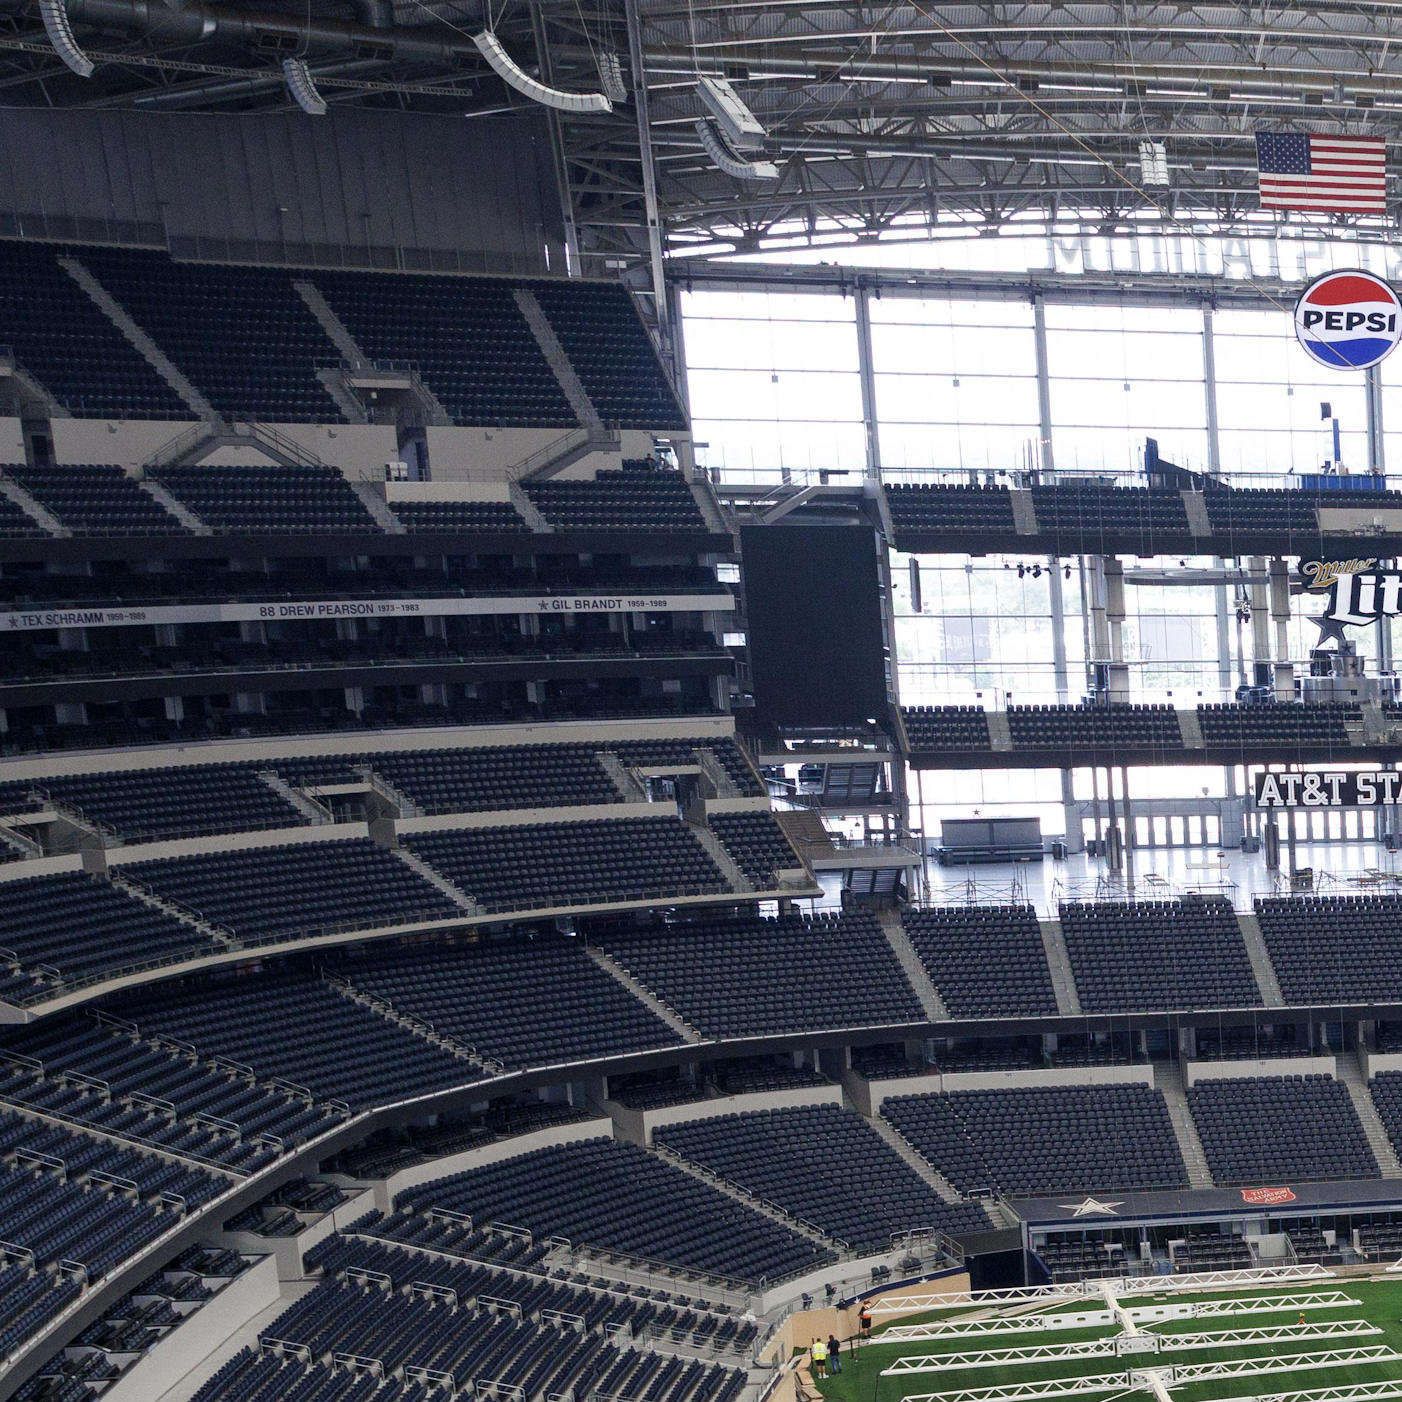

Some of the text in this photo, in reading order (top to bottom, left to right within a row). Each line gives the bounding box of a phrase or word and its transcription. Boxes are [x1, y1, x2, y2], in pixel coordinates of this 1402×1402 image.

[1303, 310, 1396, 333] PEPSI
[1303, 557, 1378, 589] Miller
[259, 606, 275, 617] 88
[280, 605, 315, 616] DREW
[318, 603, 374, 615] PEARSON
[552, 599, 572, 610] GIL
[574, 599, 623, 609] BRANDT
[21, 614, 42, 627] TEX
[46, 611, 104, 626] SCHRAMM
[1258, 773, 1347, 807] AT&T
